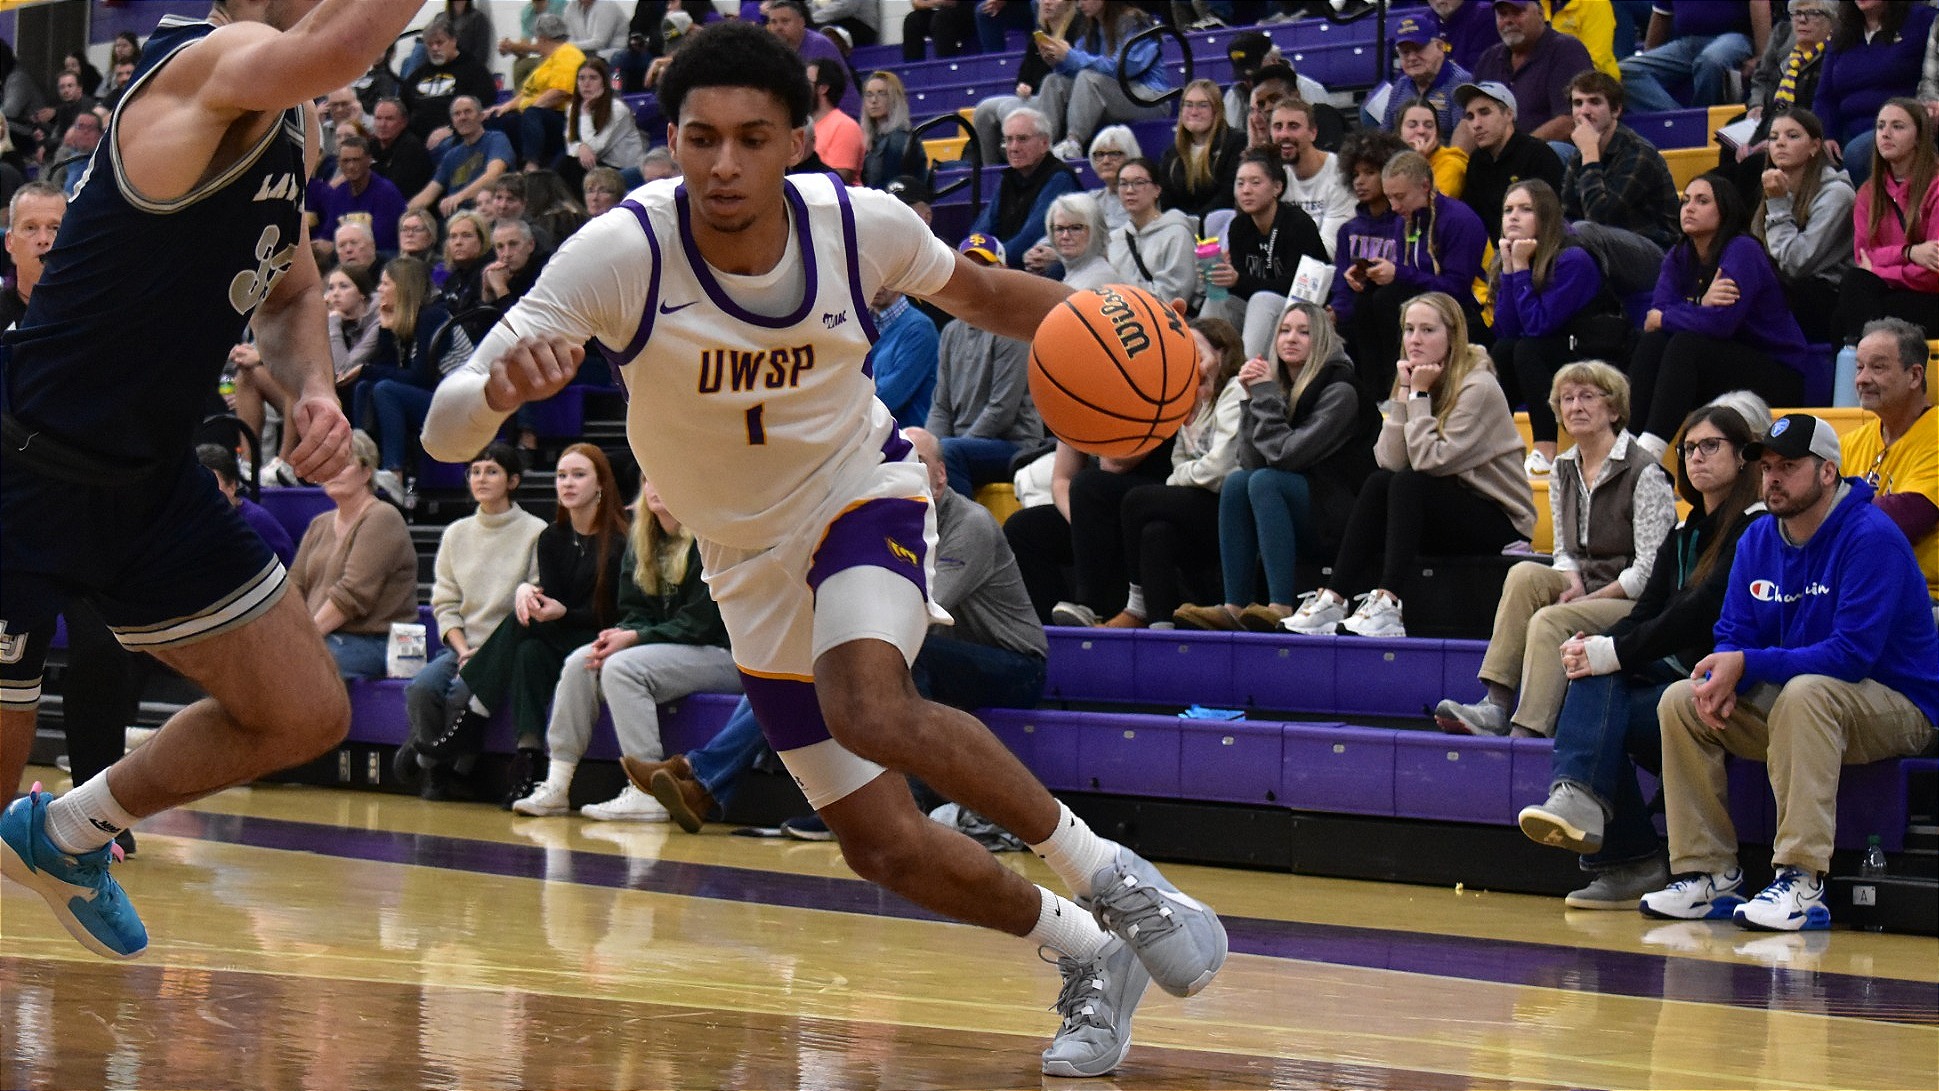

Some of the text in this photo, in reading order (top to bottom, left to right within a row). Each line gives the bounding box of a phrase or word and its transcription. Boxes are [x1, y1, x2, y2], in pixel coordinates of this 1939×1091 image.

[1093, 287, 1151, 361] Wils
[698, 343, 814, 394] UWSP
[744, 402, 767, 446] 1
[1860, 889, 1868, 902] A
